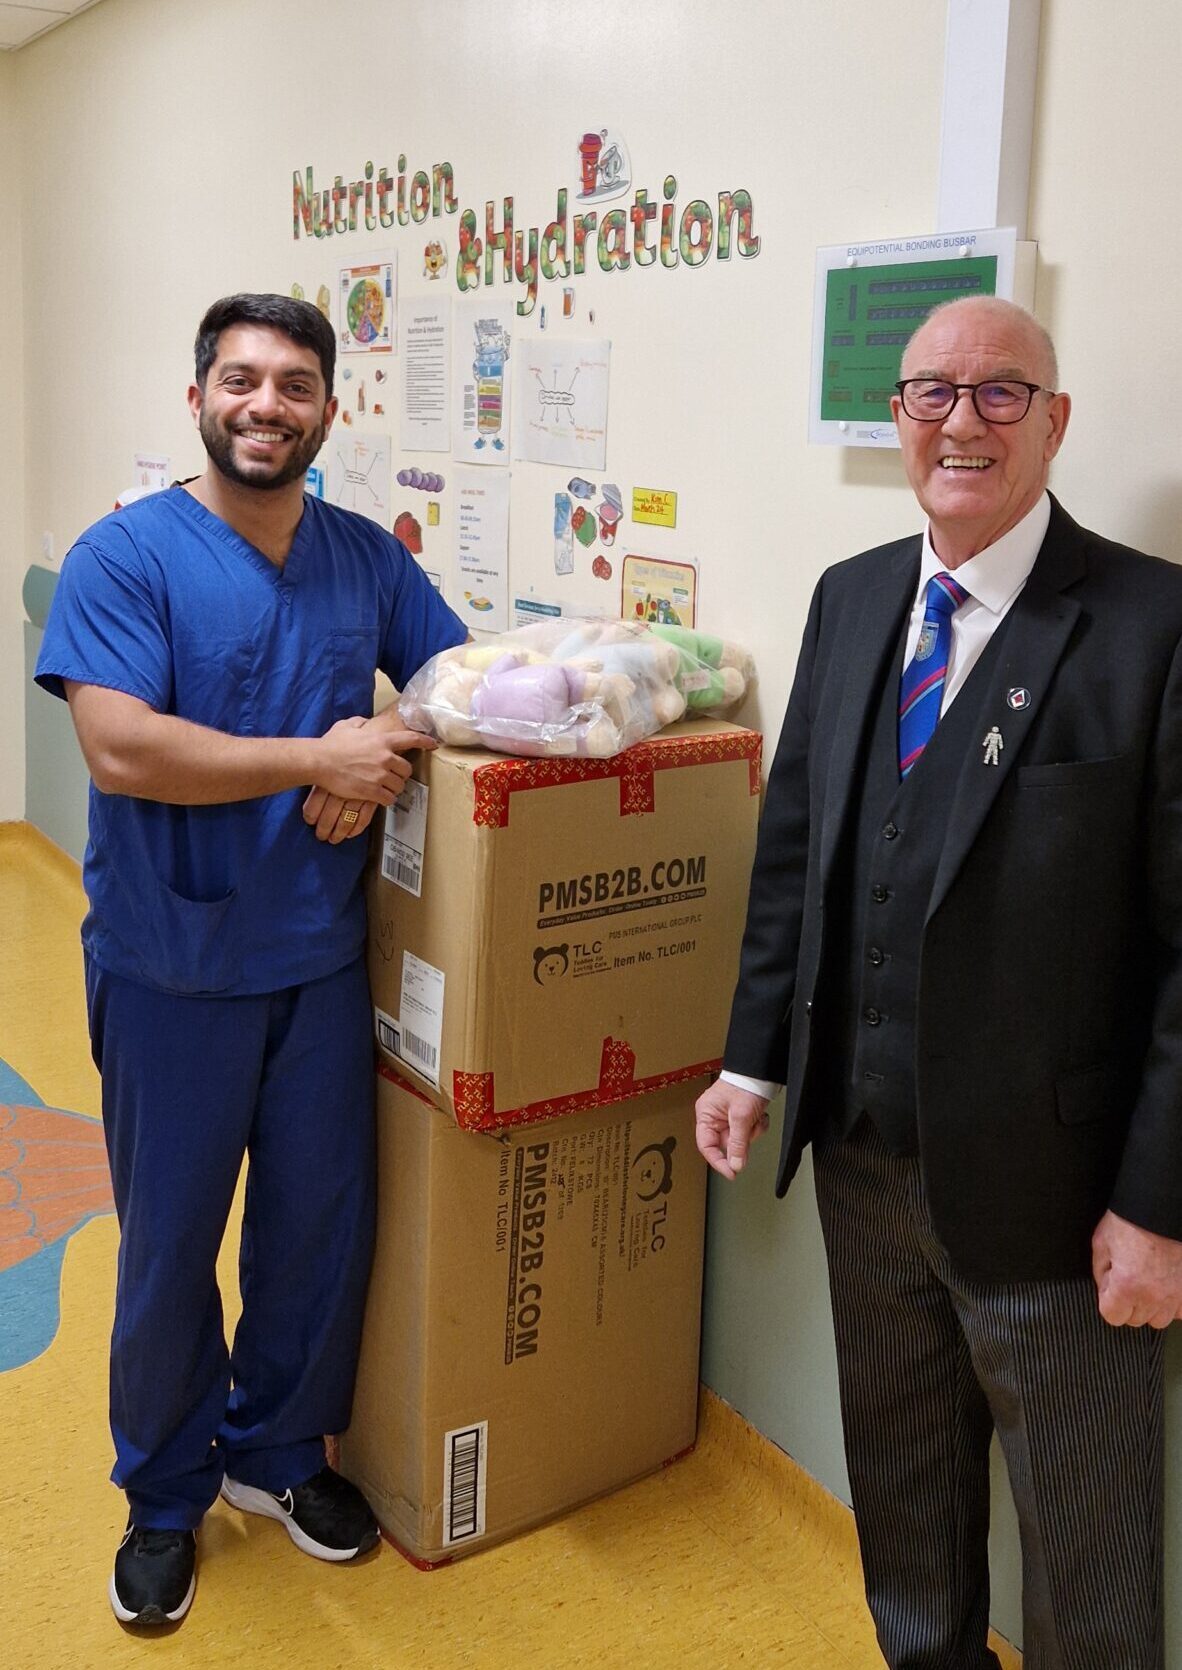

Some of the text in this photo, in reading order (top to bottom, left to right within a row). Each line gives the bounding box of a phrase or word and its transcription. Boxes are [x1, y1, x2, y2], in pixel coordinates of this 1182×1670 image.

[292, 154, 459, 240] Nutrition
[847, 236, 977, 256] EQUIPOTENTIAL BONDING BUSBAR
[539, 856, 706, 913] PMSB2B.COM
[622, 922, 668, 938] INTERNATIONAL
[670, 916, 690, 928] GROUP
[691, 914, 703, 924] PLC
[573, 940, 602, 957] TLC
[613, 940, 696, 968] Item No. TLC/001
[466, 1075, 479, 1087] TLC
[496, 1150, 511, 1252] Item No TLC/001
[567, 1157, 576, 1206] FELIXSTOWE
[651, 1201, 667, 1252] TLC
[516, 1142, 550, 1359] PMSB2B.COM
[597, 1244, 605, 1286] ASSORTED
[596, 1288, 604, 1327] COLOURS
